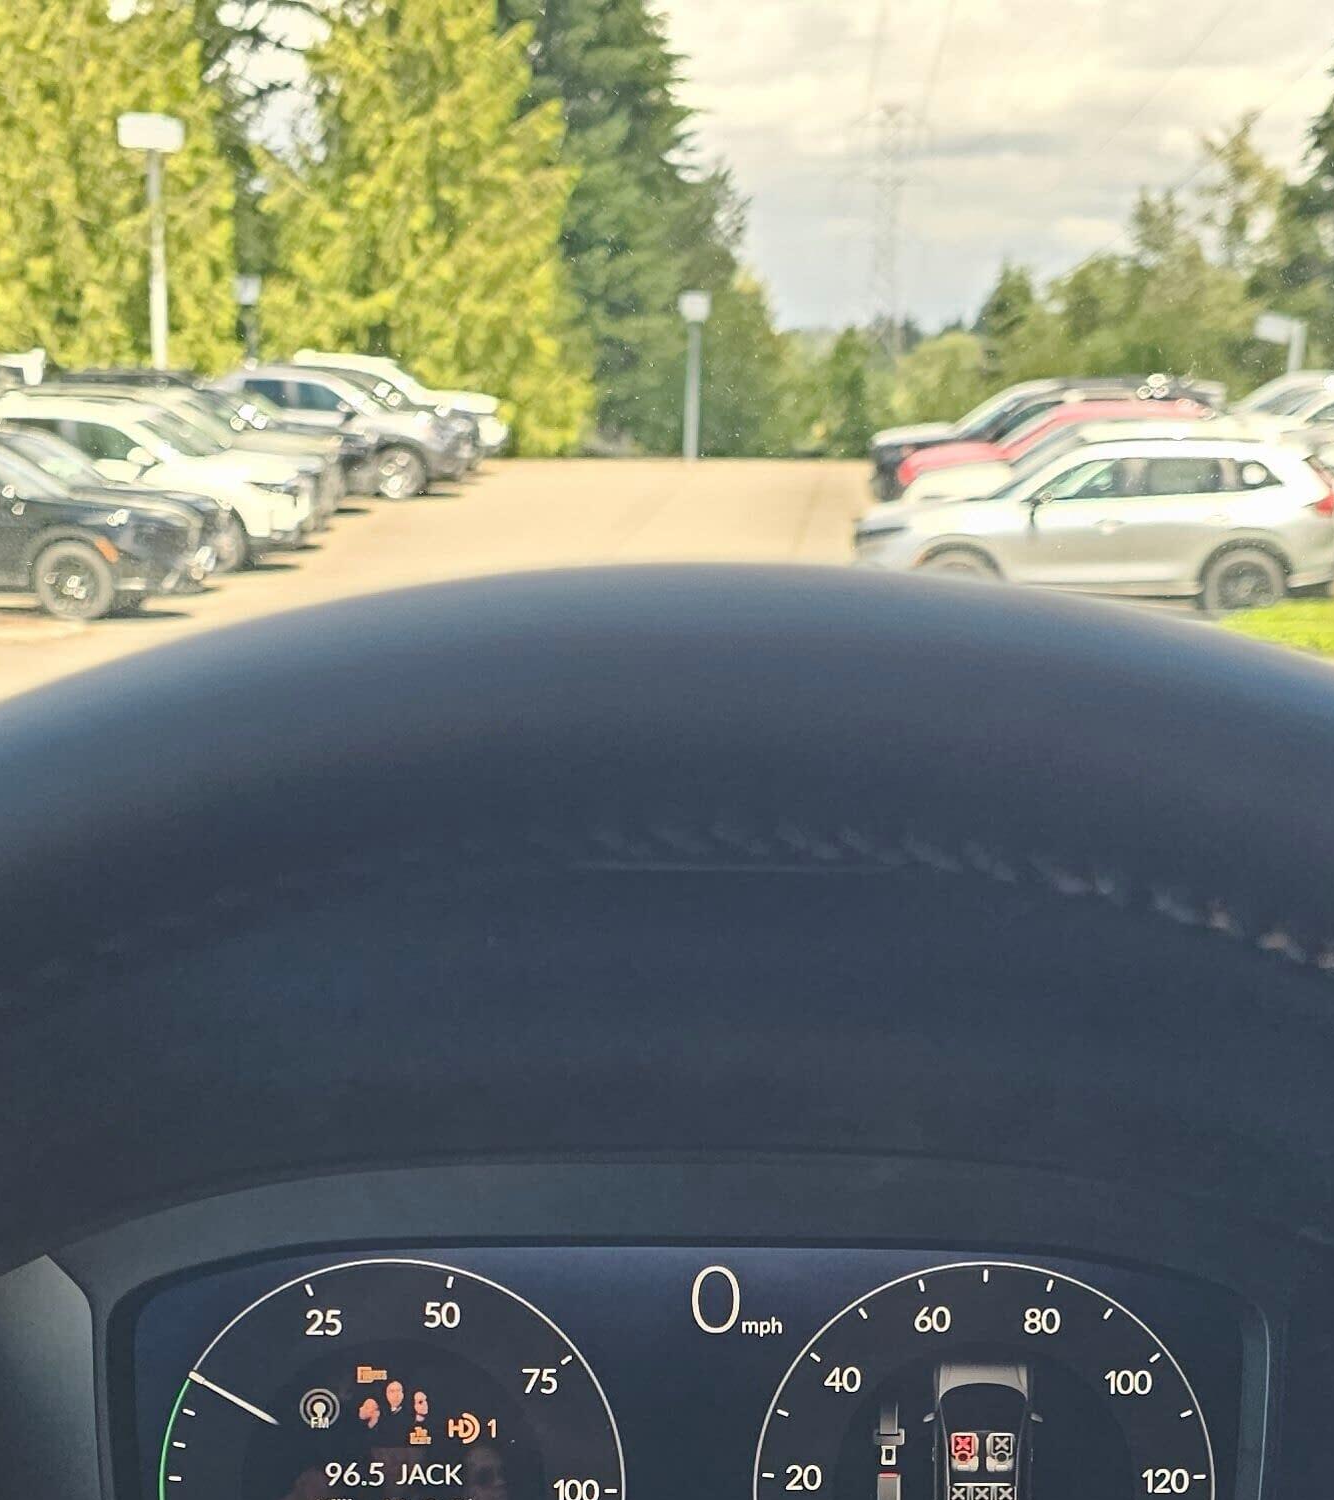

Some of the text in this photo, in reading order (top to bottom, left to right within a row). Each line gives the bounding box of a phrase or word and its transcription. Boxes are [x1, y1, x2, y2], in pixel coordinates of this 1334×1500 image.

[423, 1302, 461, 1329] 50
[692, 1266, 783, 1338] 0 mph
[305, 1309, 343, 1336] 25
[914, 1306, 952, 1333] 60
[1023, 1307, 1061, 1335] 80
[521, 1368, 558, 1395] 75
[823, 1366, 862, 1393] 40
[1104, 1369, 1153, 1395] 100
[310, 1416, 329, 1429] FM
[487, 1418, 497, 1439] 1
[325, 1462, 463, 1487] 96.5 JACK
[785, 1464, 822, 1491] 20
[1141, 1468, 1190, 1494] 120
